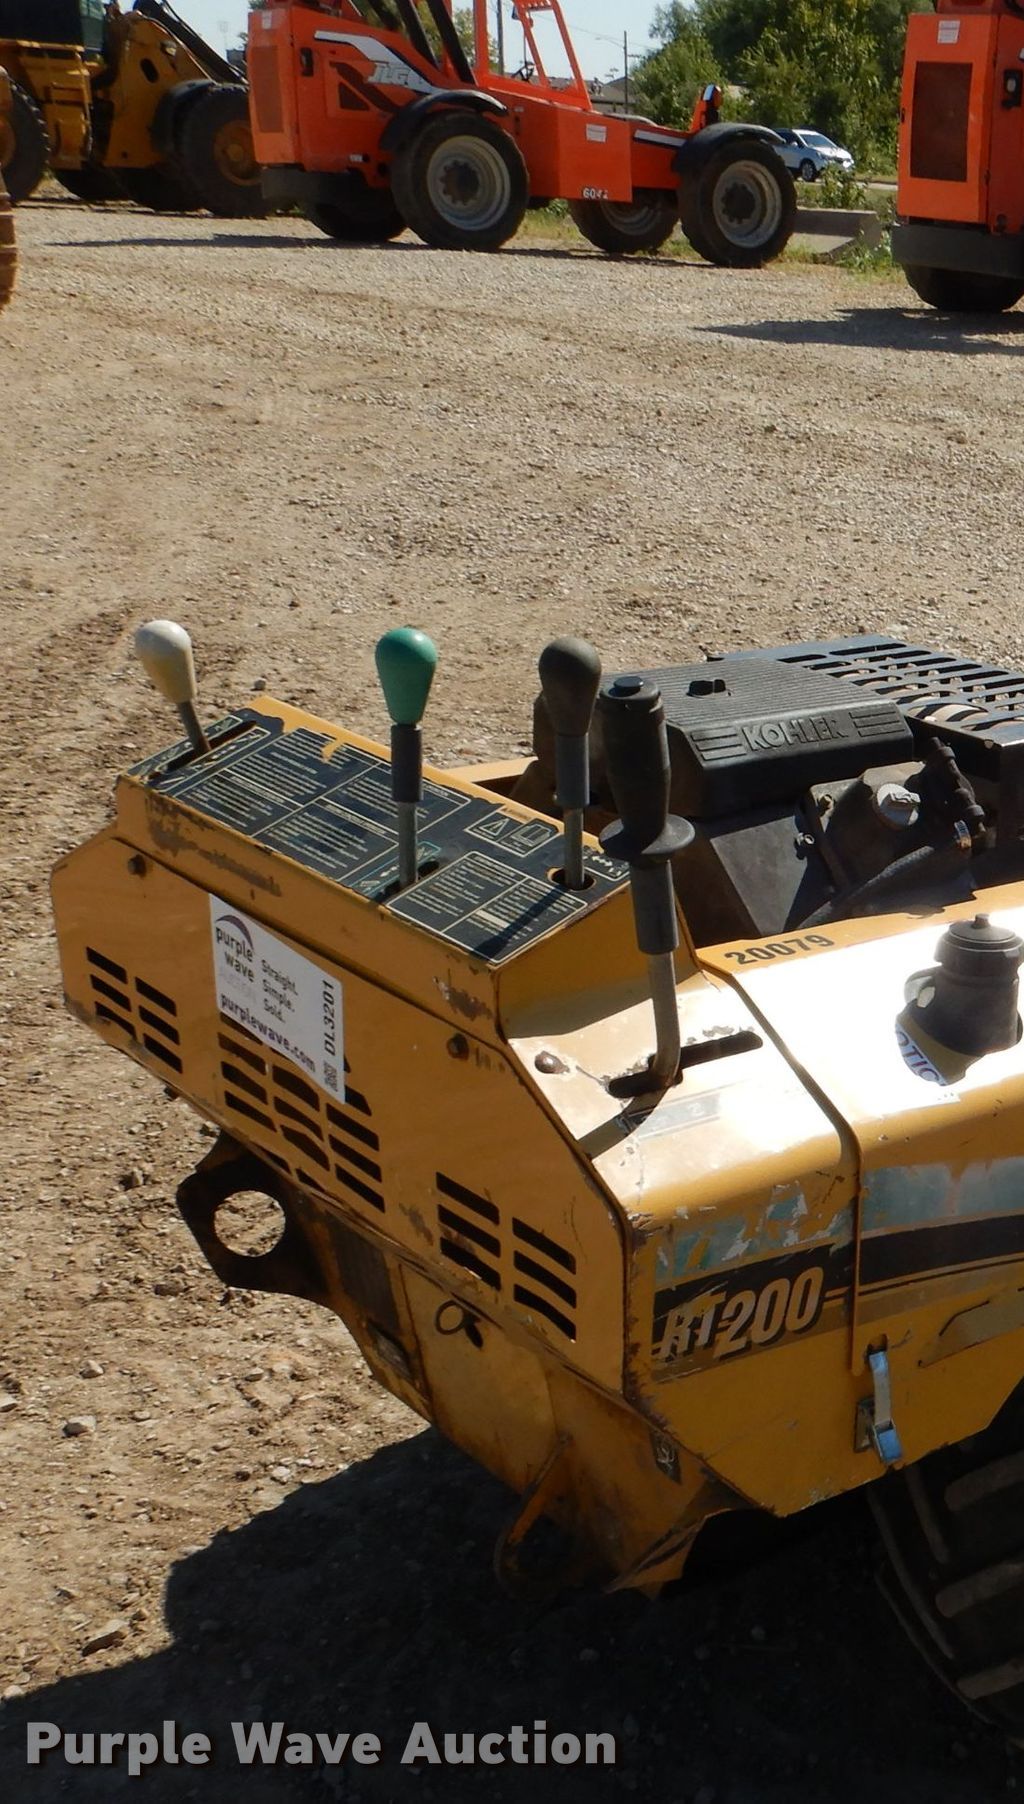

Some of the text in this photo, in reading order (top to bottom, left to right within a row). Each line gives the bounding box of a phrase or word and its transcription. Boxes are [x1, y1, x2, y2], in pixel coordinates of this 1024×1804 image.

[742, 716, 848, 751] KOHLER
[215, 927, 254, 962] purple
[724, 935, 835, 965] 20079
[224, 951, 255, 983] wave
[221, 994, 316, 1072] purplewave.com
[322, 980, 336, 1057] DL3201
